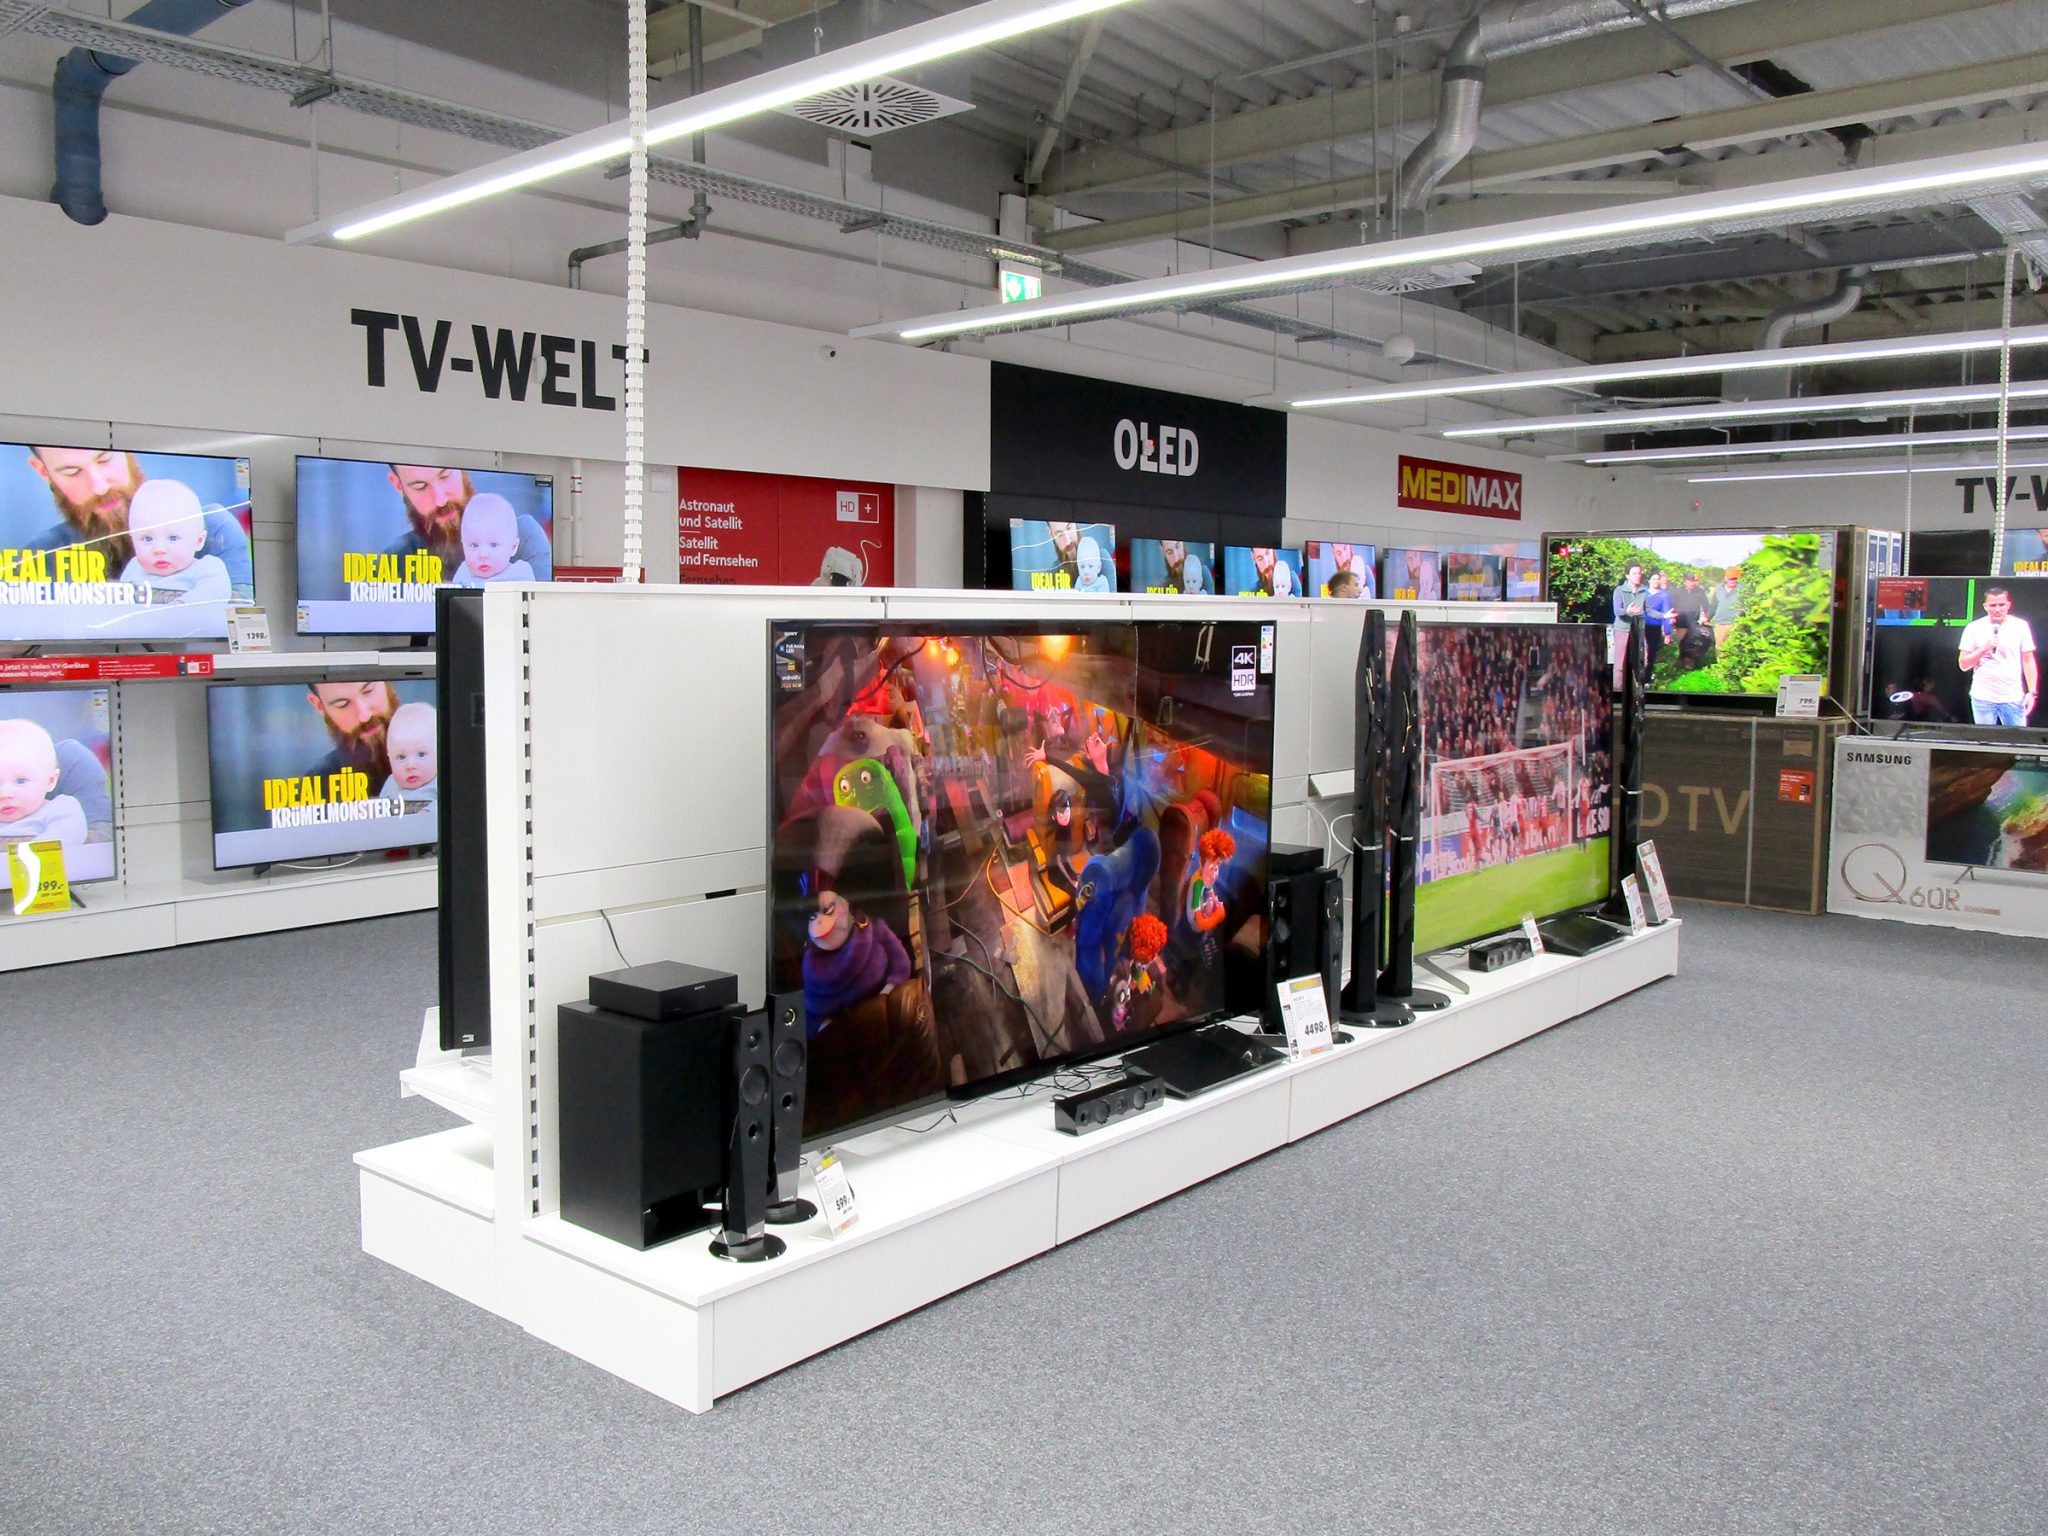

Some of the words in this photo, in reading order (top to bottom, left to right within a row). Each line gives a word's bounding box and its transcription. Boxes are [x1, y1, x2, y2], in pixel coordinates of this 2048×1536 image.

[351, 308, 649, 411] TV-WEL
[1114, 418, 1199, 476] OLED
[1402, 465, 1520, 511] MEDIMAX
[679, 498, 735, 514] Astronaut
[840, 500, 855, 513] HD
[679, 515, 701, 528] und
[704, 516, 743, 530] Satellit
[679, 535, 719, 550] Satellit
[54, 543, 107, 582] FÜR
[343, 552, 401, 583] IDEAL
[404, 548, 442, 583] FÜR
[679, 554, 701, 565] und
[703, 554, 758, 568] Fernsehen
[1031, 572, 1055, 589] IDEAL
[1234, 652, 1254, 665] 4K
[1234, 674, 1254, 687] HDR
[1847, 752, 1912, 765] SAMSUNG
[263, 775, 326, 811] IDEAL
[328, 766, 369, 804] FÜR
